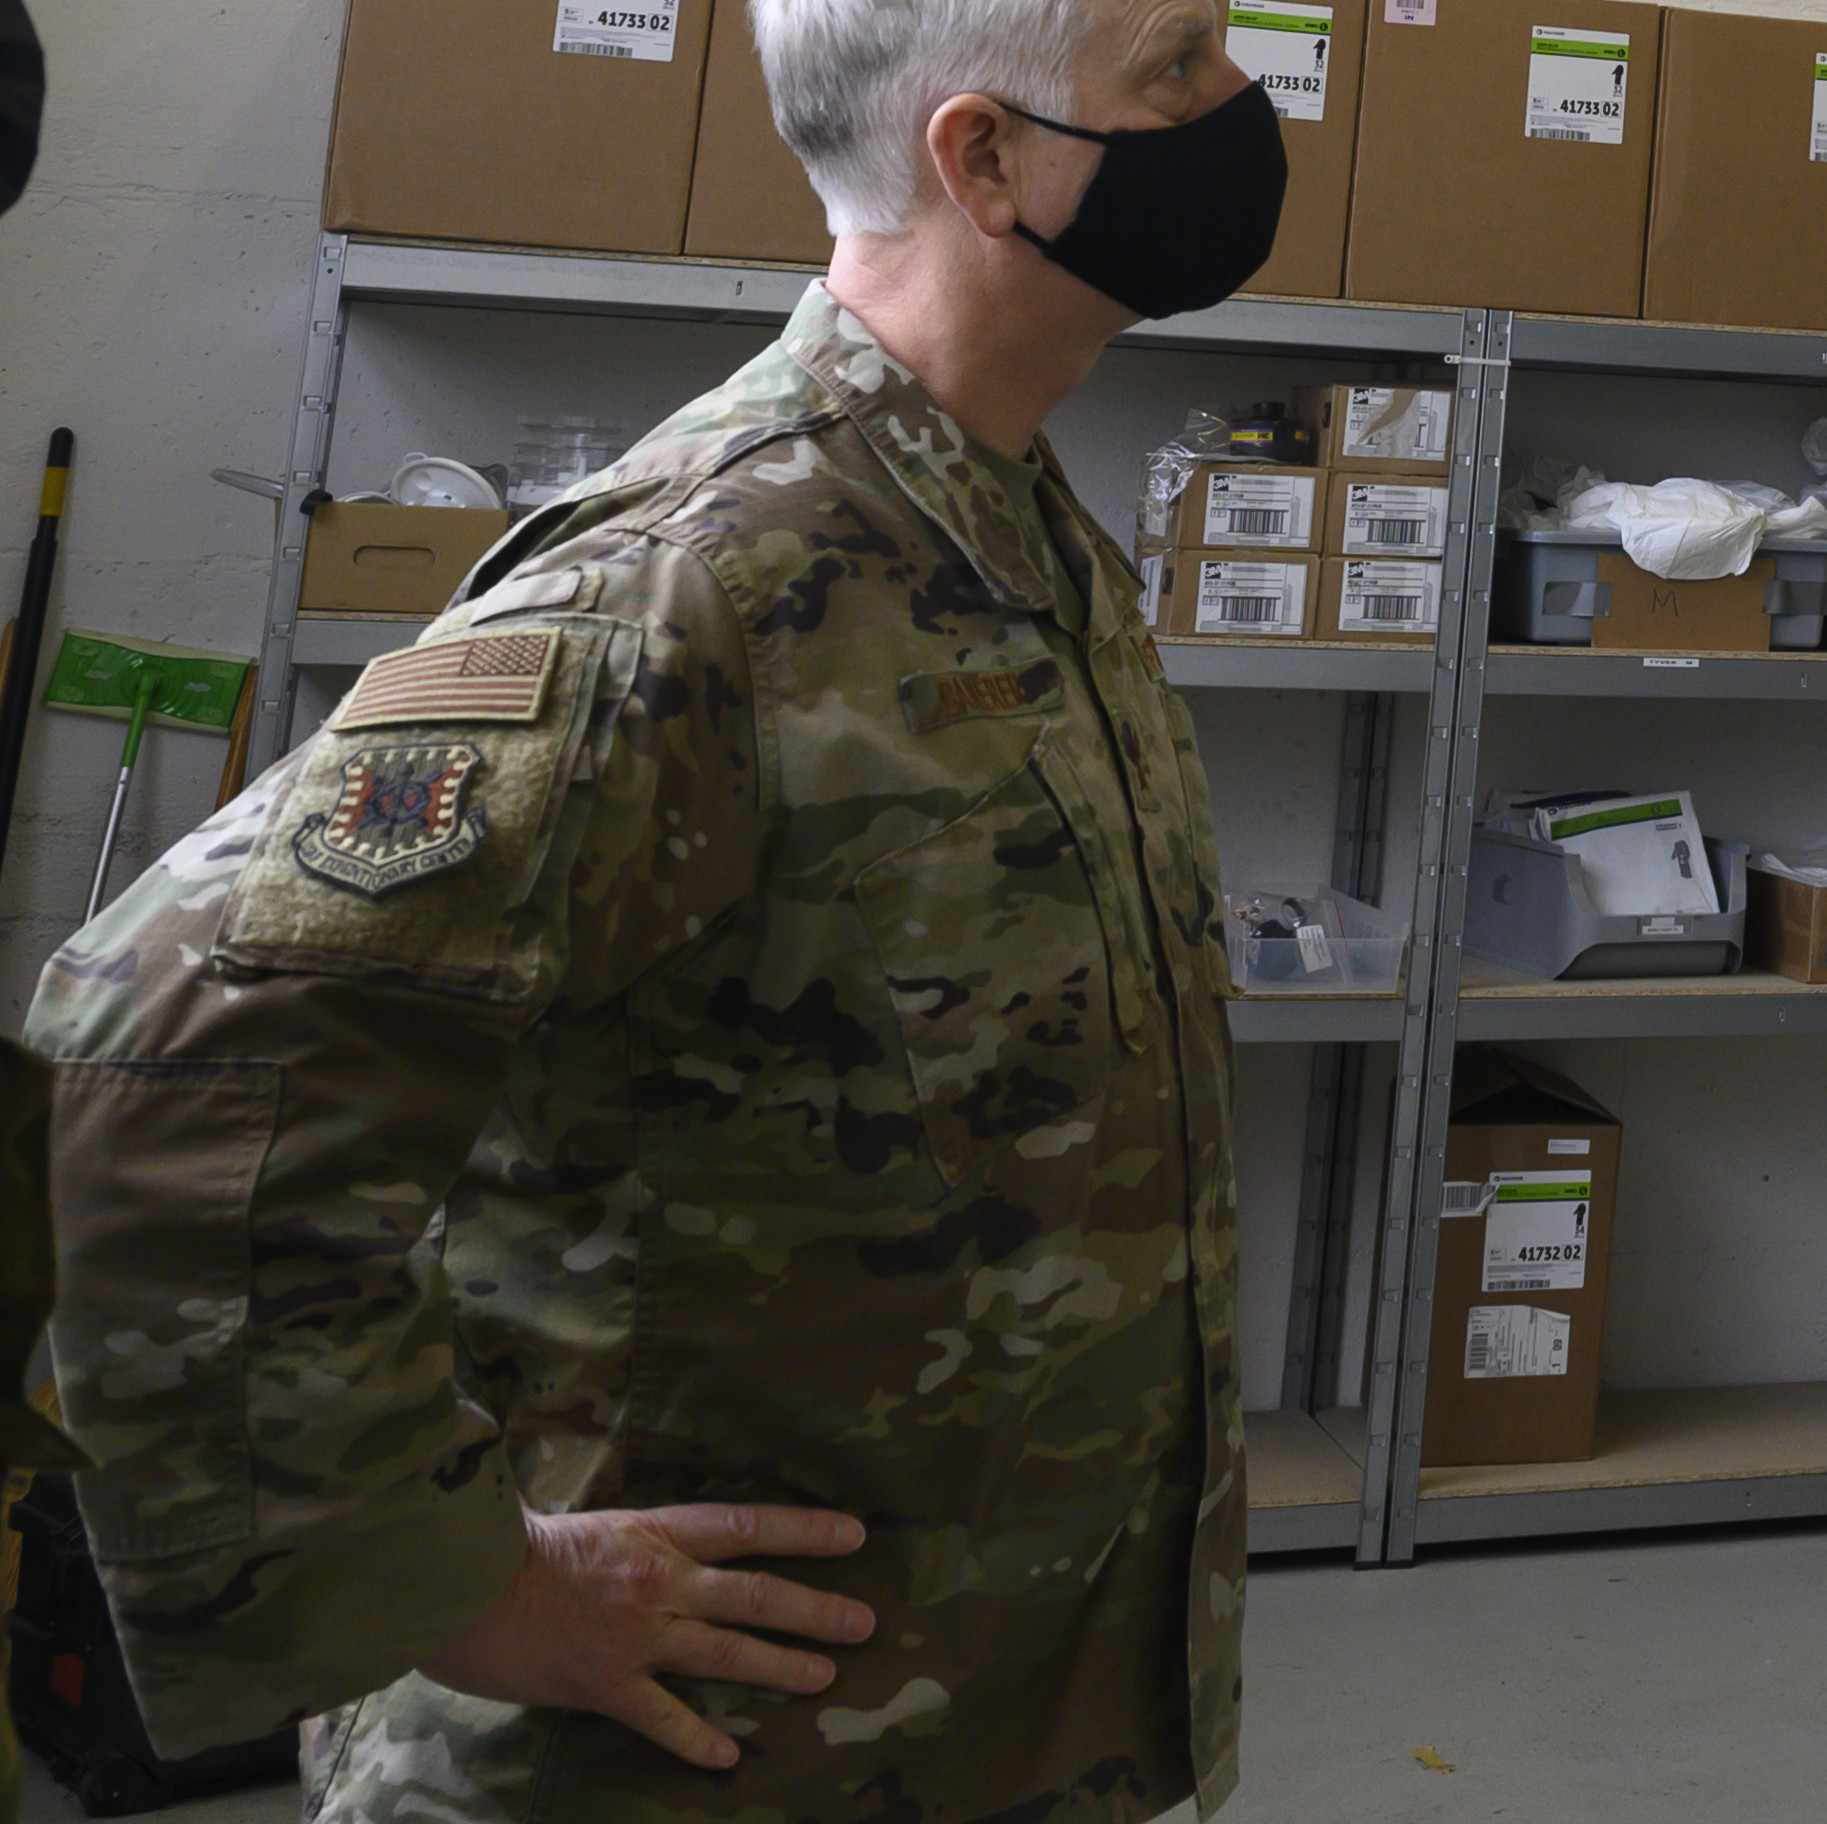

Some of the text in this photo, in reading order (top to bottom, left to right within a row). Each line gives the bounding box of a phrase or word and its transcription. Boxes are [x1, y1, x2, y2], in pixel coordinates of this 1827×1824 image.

[597, 11, 670, 31] 41733 02
[1303, 77, 1320, 92] 02
[1560, 99, 1619, 116] 41733 02
[1652, 588, 1679, 617] M
[1518, 1245, 1581, 1262] 41732 02
